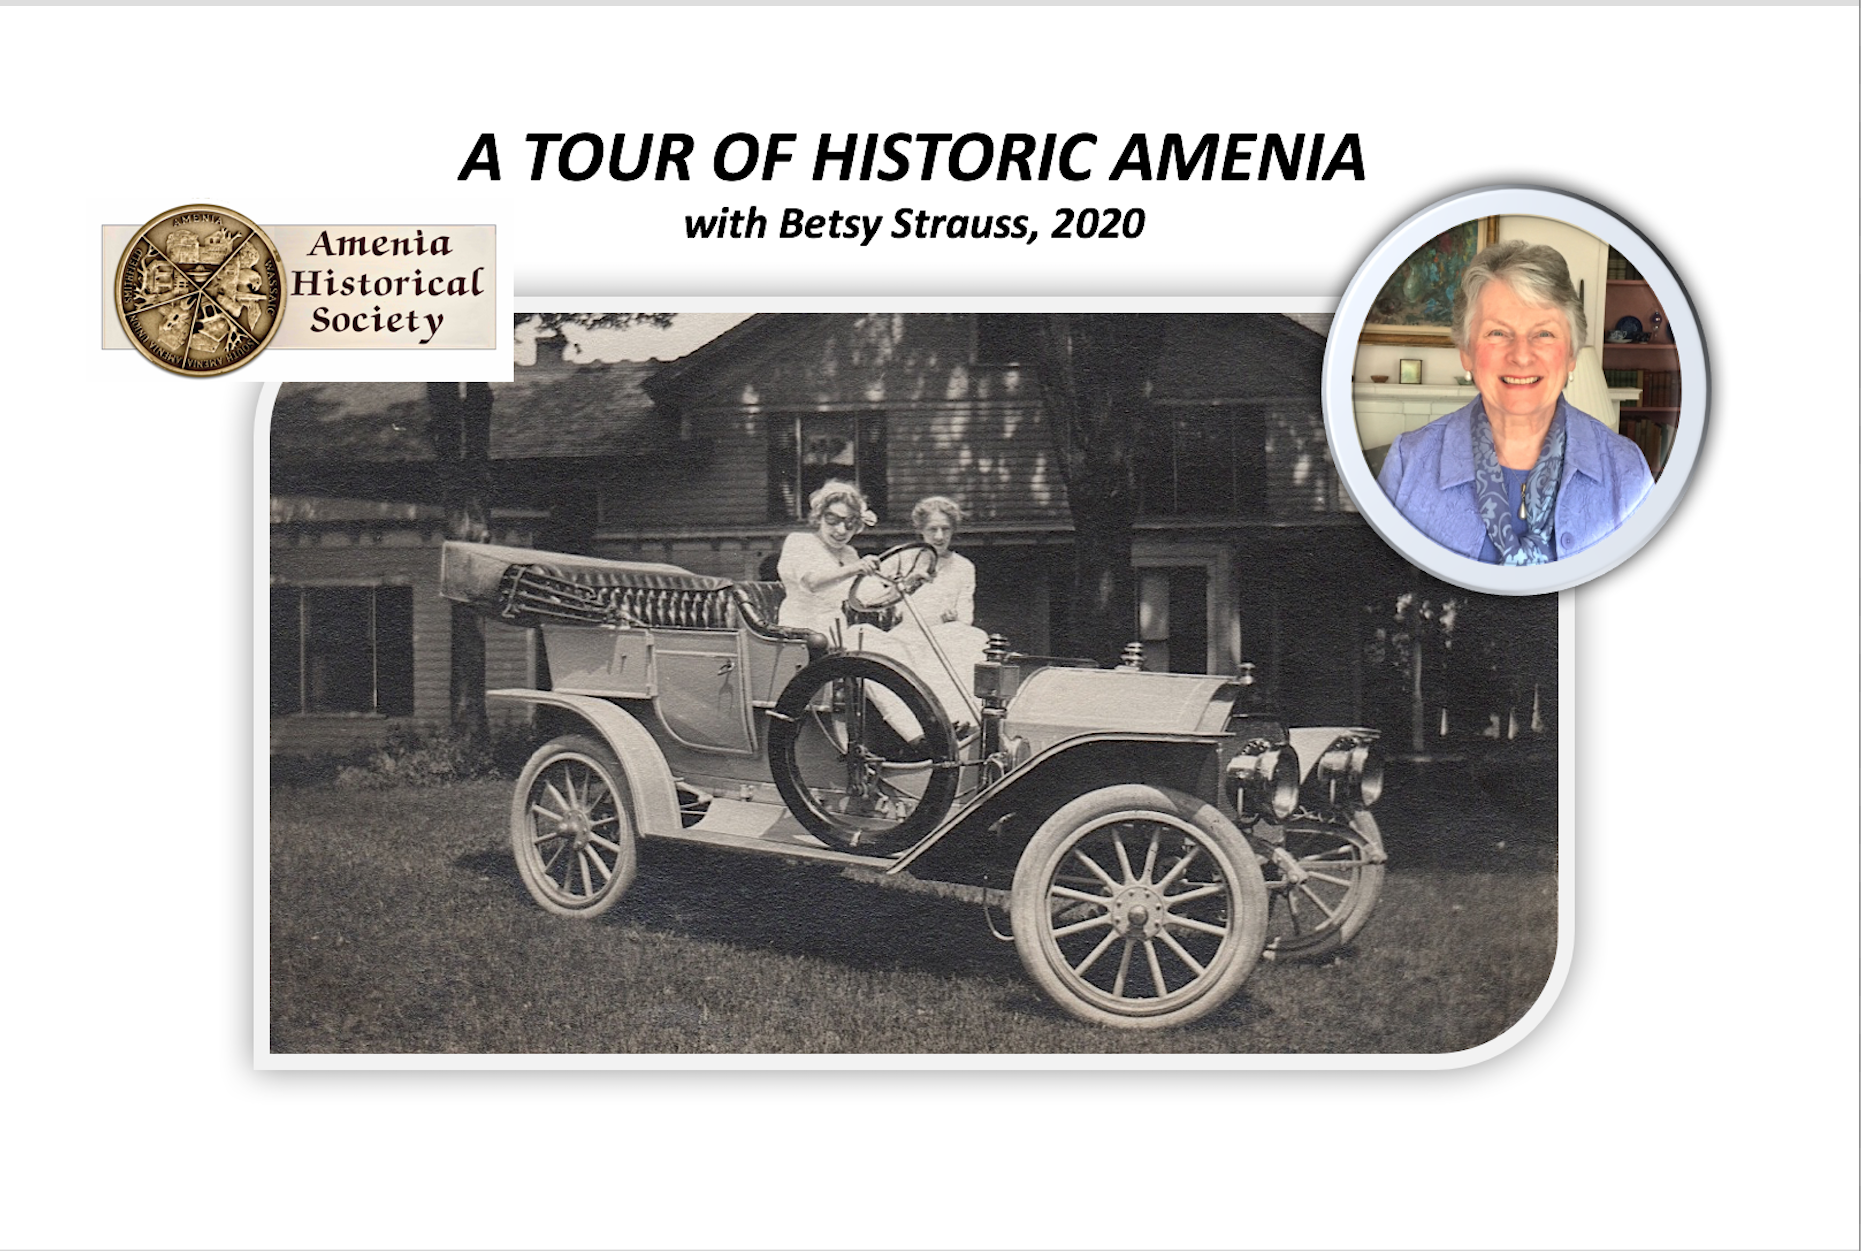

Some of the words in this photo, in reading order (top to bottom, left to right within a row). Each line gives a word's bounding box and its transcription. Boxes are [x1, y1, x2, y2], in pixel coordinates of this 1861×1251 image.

[173, 214, 223, 228] AMENIA
[124, 248, 143, 304] SMITHFIELD
[264, 260, 279, 316] WASSAIC
